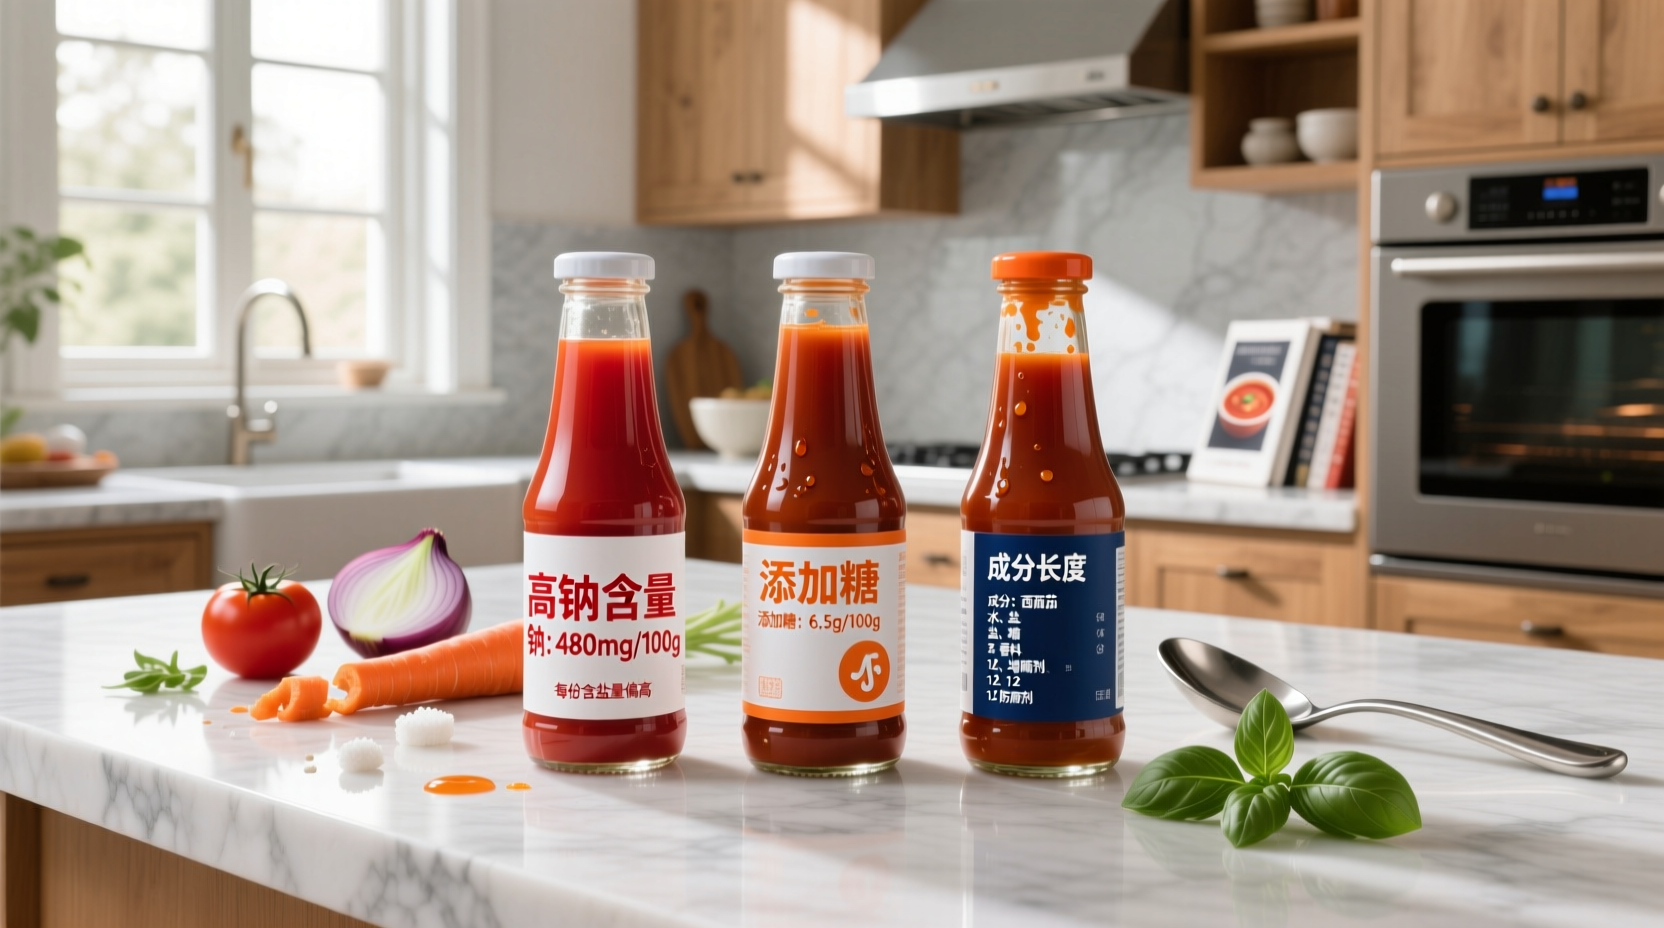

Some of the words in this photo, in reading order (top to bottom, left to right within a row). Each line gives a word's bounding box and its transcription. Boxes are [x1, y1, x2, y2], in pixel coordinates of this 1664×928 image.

[759, 559, 880, 605] 添加糖
[987, 552, 1088, 583] 成分长度
[528, 572, 676, 622] 高钠含量
